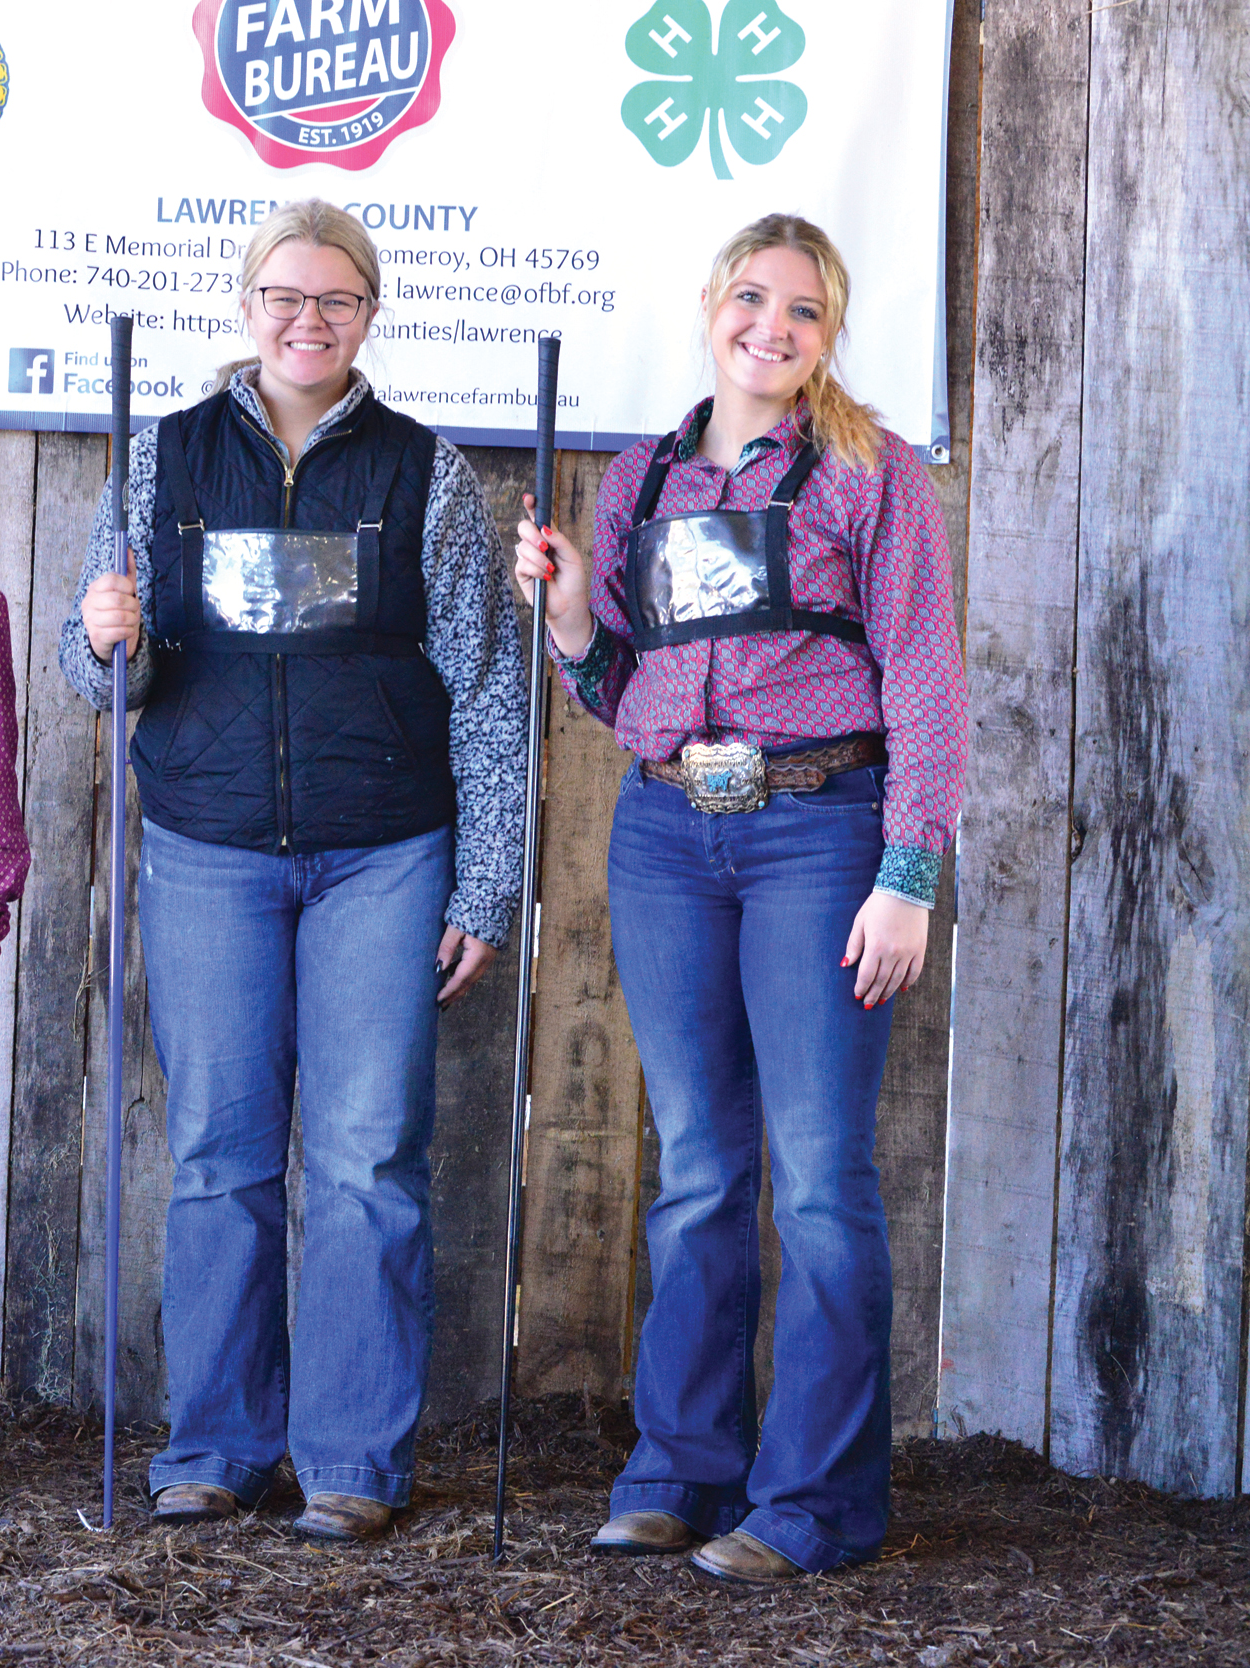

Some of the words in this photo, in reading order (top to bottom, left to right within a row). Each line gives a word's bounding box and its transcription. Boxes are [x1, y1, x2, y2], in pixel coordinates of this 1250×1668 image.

[236, 0, 400, 52] FARM
[245, 31, 419, 107] BUREAU
[298, 126, 337, 145] EST.
[340, 111, 384, 142] 1919
[34, 229, 76, 251] 113
[85, 233, 97, 253] E
[106, 234, 211, 259] Memorial
[379, 249, 470, 273] omeroy,
[479, 247, 516, 268] OH
[525, 248, 600, 271] 45769
[1, 260, 78, 284] Phone:
[397, 277, 616, 312] lawrence@ofbf.org
[368, 319, 563, 344] ounties/lawrence
[65, 351, 99, 366] Find
